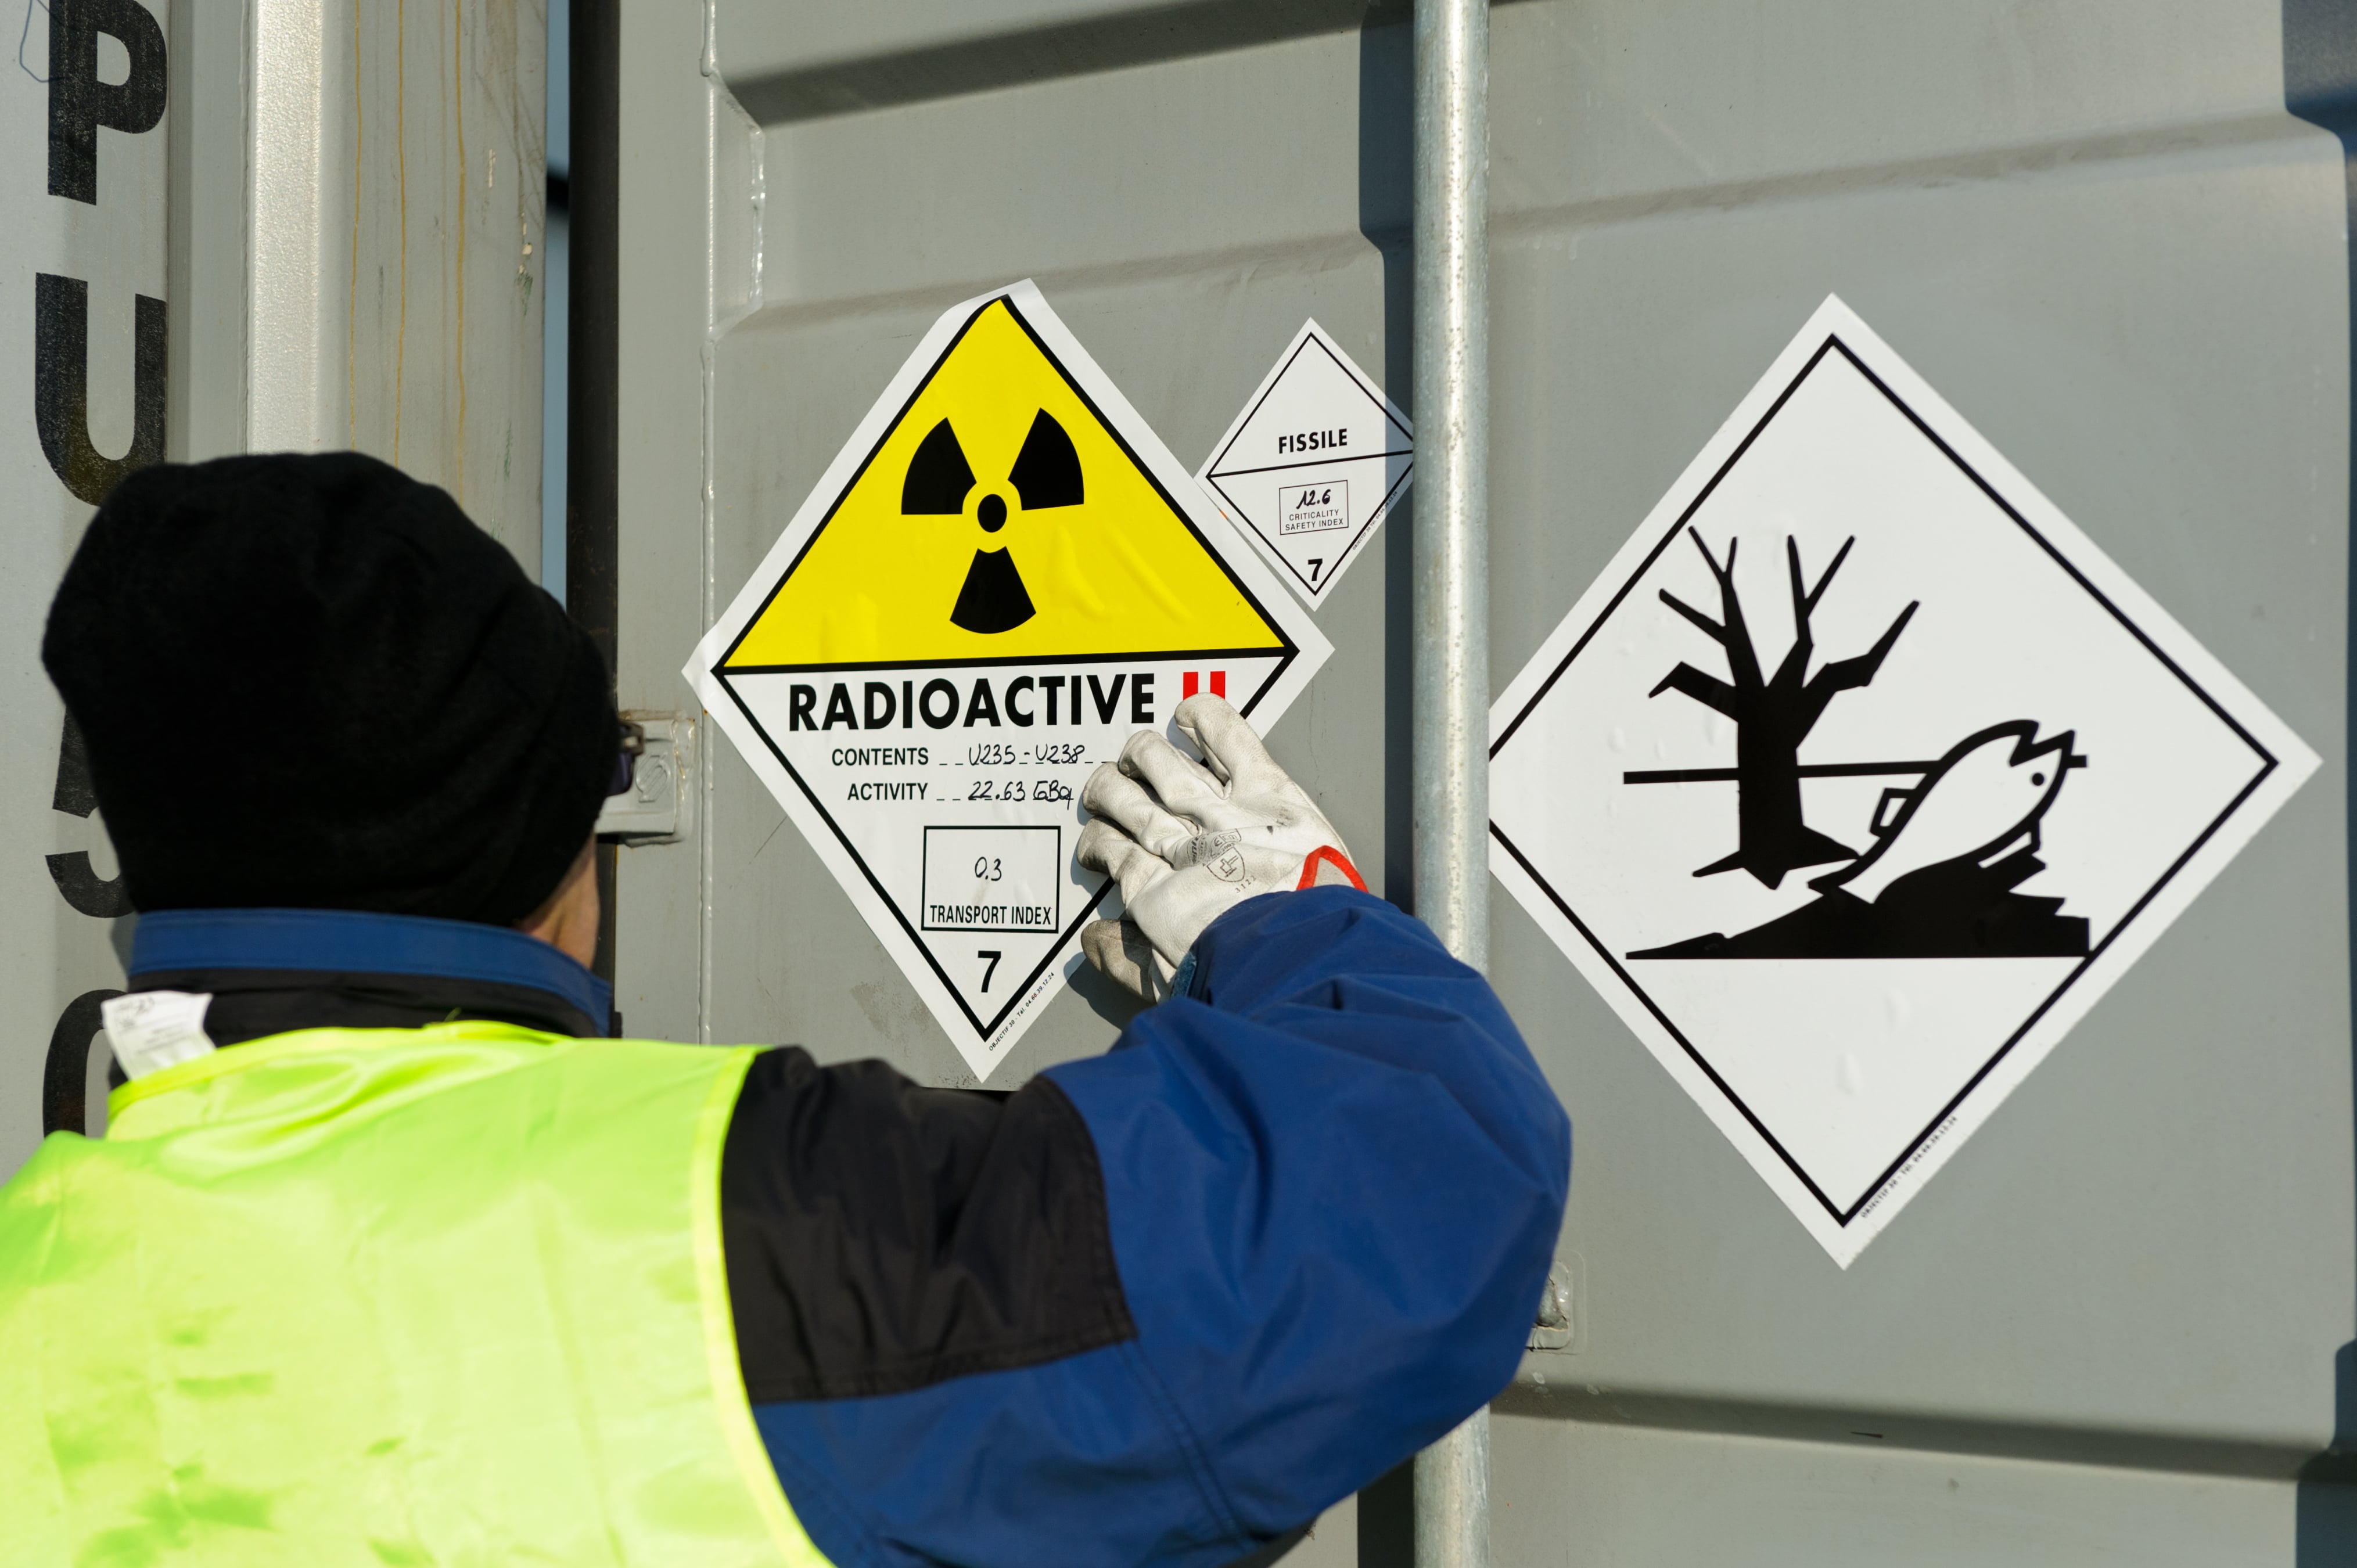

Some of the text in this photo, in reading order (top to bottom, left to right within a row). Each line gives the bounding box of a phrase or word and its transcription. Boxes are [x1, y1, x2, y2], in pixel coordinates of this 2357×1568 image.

[1278, 428, 1348, 454] FISSILE
[1296, 488, 1331, 510] 12.6
[1285, 518, 1343, 531] SAFETY INDEX
[1289, 509, 1339, 521] CRITICALITY
[1307, 558, 1323, 581] 7
[789, 672, 1155, 732] RADIOACTIVE
[832, 747, 929, 767] CONTENTS
[847, 782, 928, 801] ACTIVITY
[968, 781, 1026, 801] 22.63
[975, 856, 1002, 882] 0.3
[1235, 875, 1256, 893] 3122
[930, 905, 1052, 925] TRANSPORT INDEX
[978, 950, 1001, 993] 7
[989, 1026, 1009, 1051] OBJECTIF
[1008, 1020, 1015, 1028] 30
[1025, 972, 1055, 1008] 04.66.39.12.24
